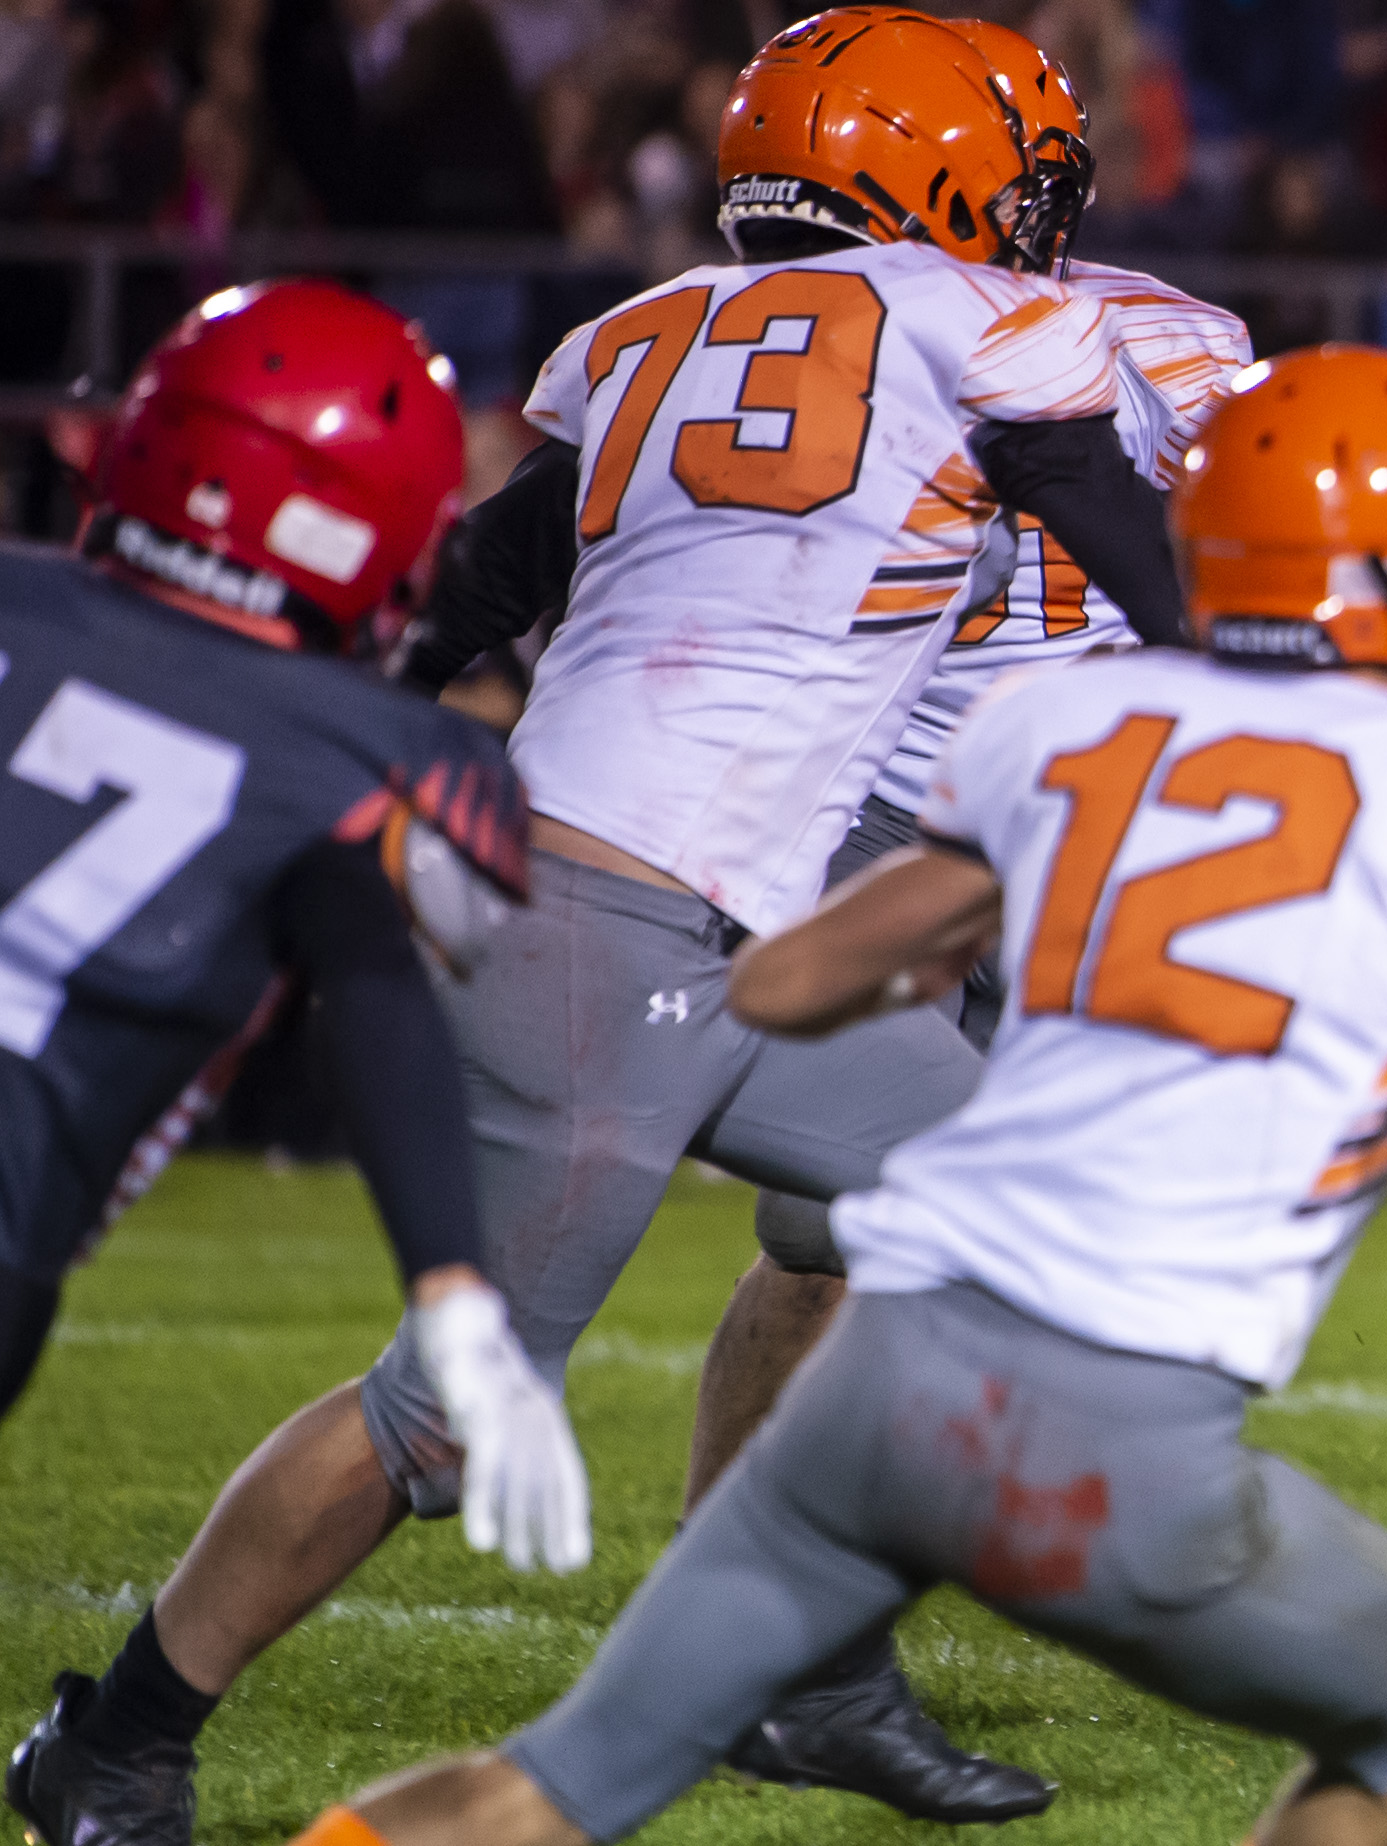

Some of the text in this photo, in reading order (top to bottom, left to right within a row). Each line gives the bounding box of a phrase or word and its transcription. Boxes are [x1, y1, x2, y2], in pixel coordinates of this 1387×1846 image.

[729, 174, 801, 202] schutt
[578, 268, 888, 544] 73
[1020, 713, 1363, 1057] 12
